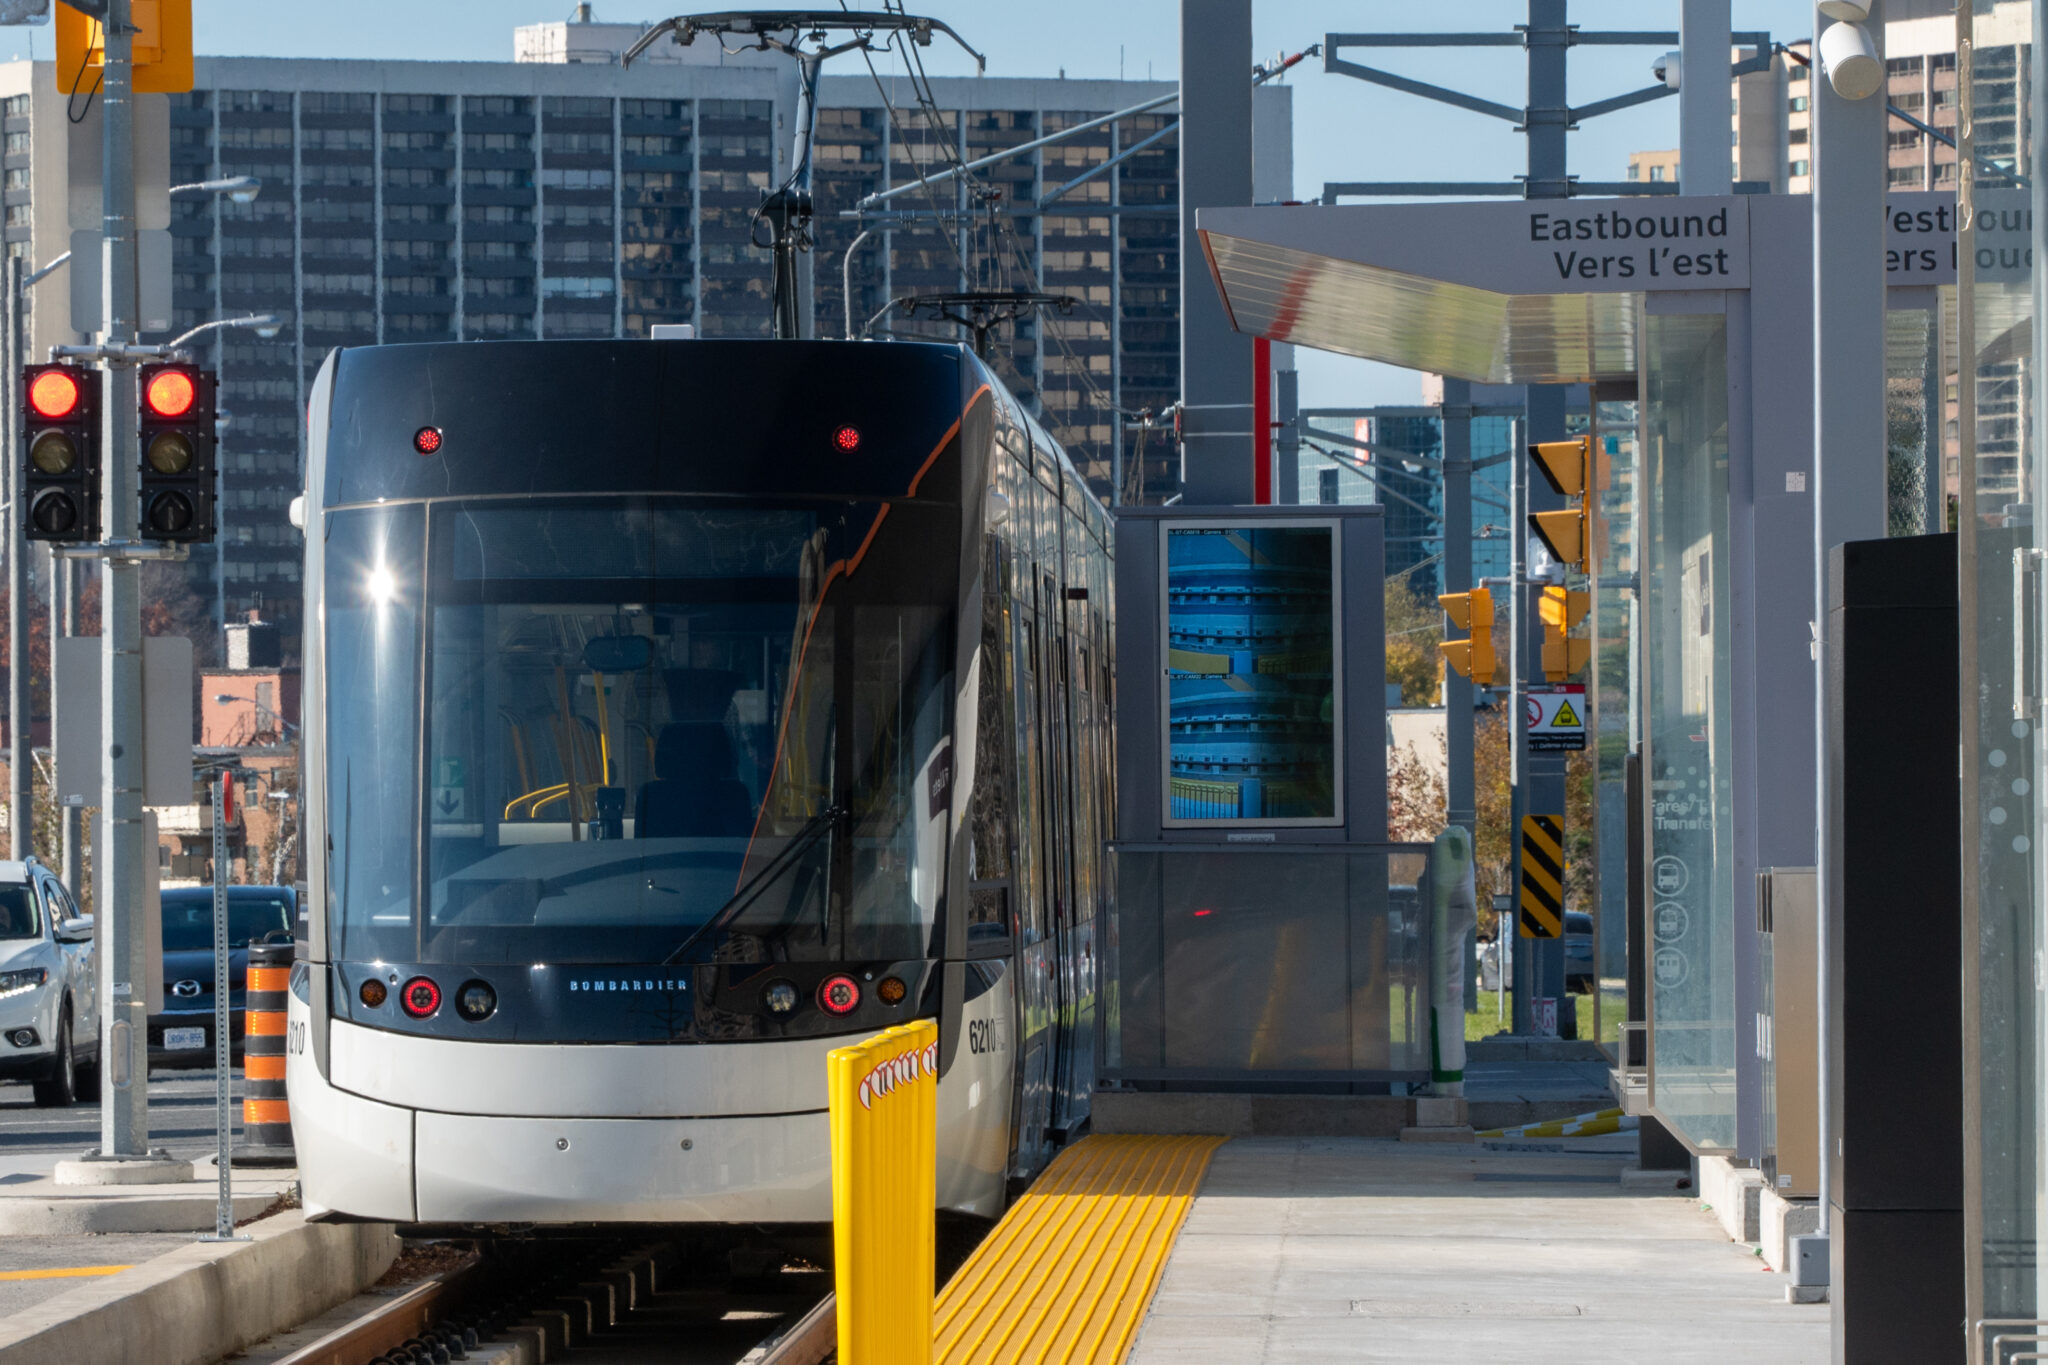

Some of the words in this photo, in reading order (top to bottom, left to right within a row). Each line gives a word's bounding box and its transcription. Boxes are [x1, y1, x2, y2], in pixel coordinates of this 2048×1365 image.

[1530, 207, 1727, 241] Eastbound
[1554, 250, 1635, 279] Vers
[1650, 247, 1729, 276] l'est
[1886, 249, 1937, 272] ers
[570, 980, 687, 991] BOMBARDIER
[969, 1018, 996, 1055] 6210
